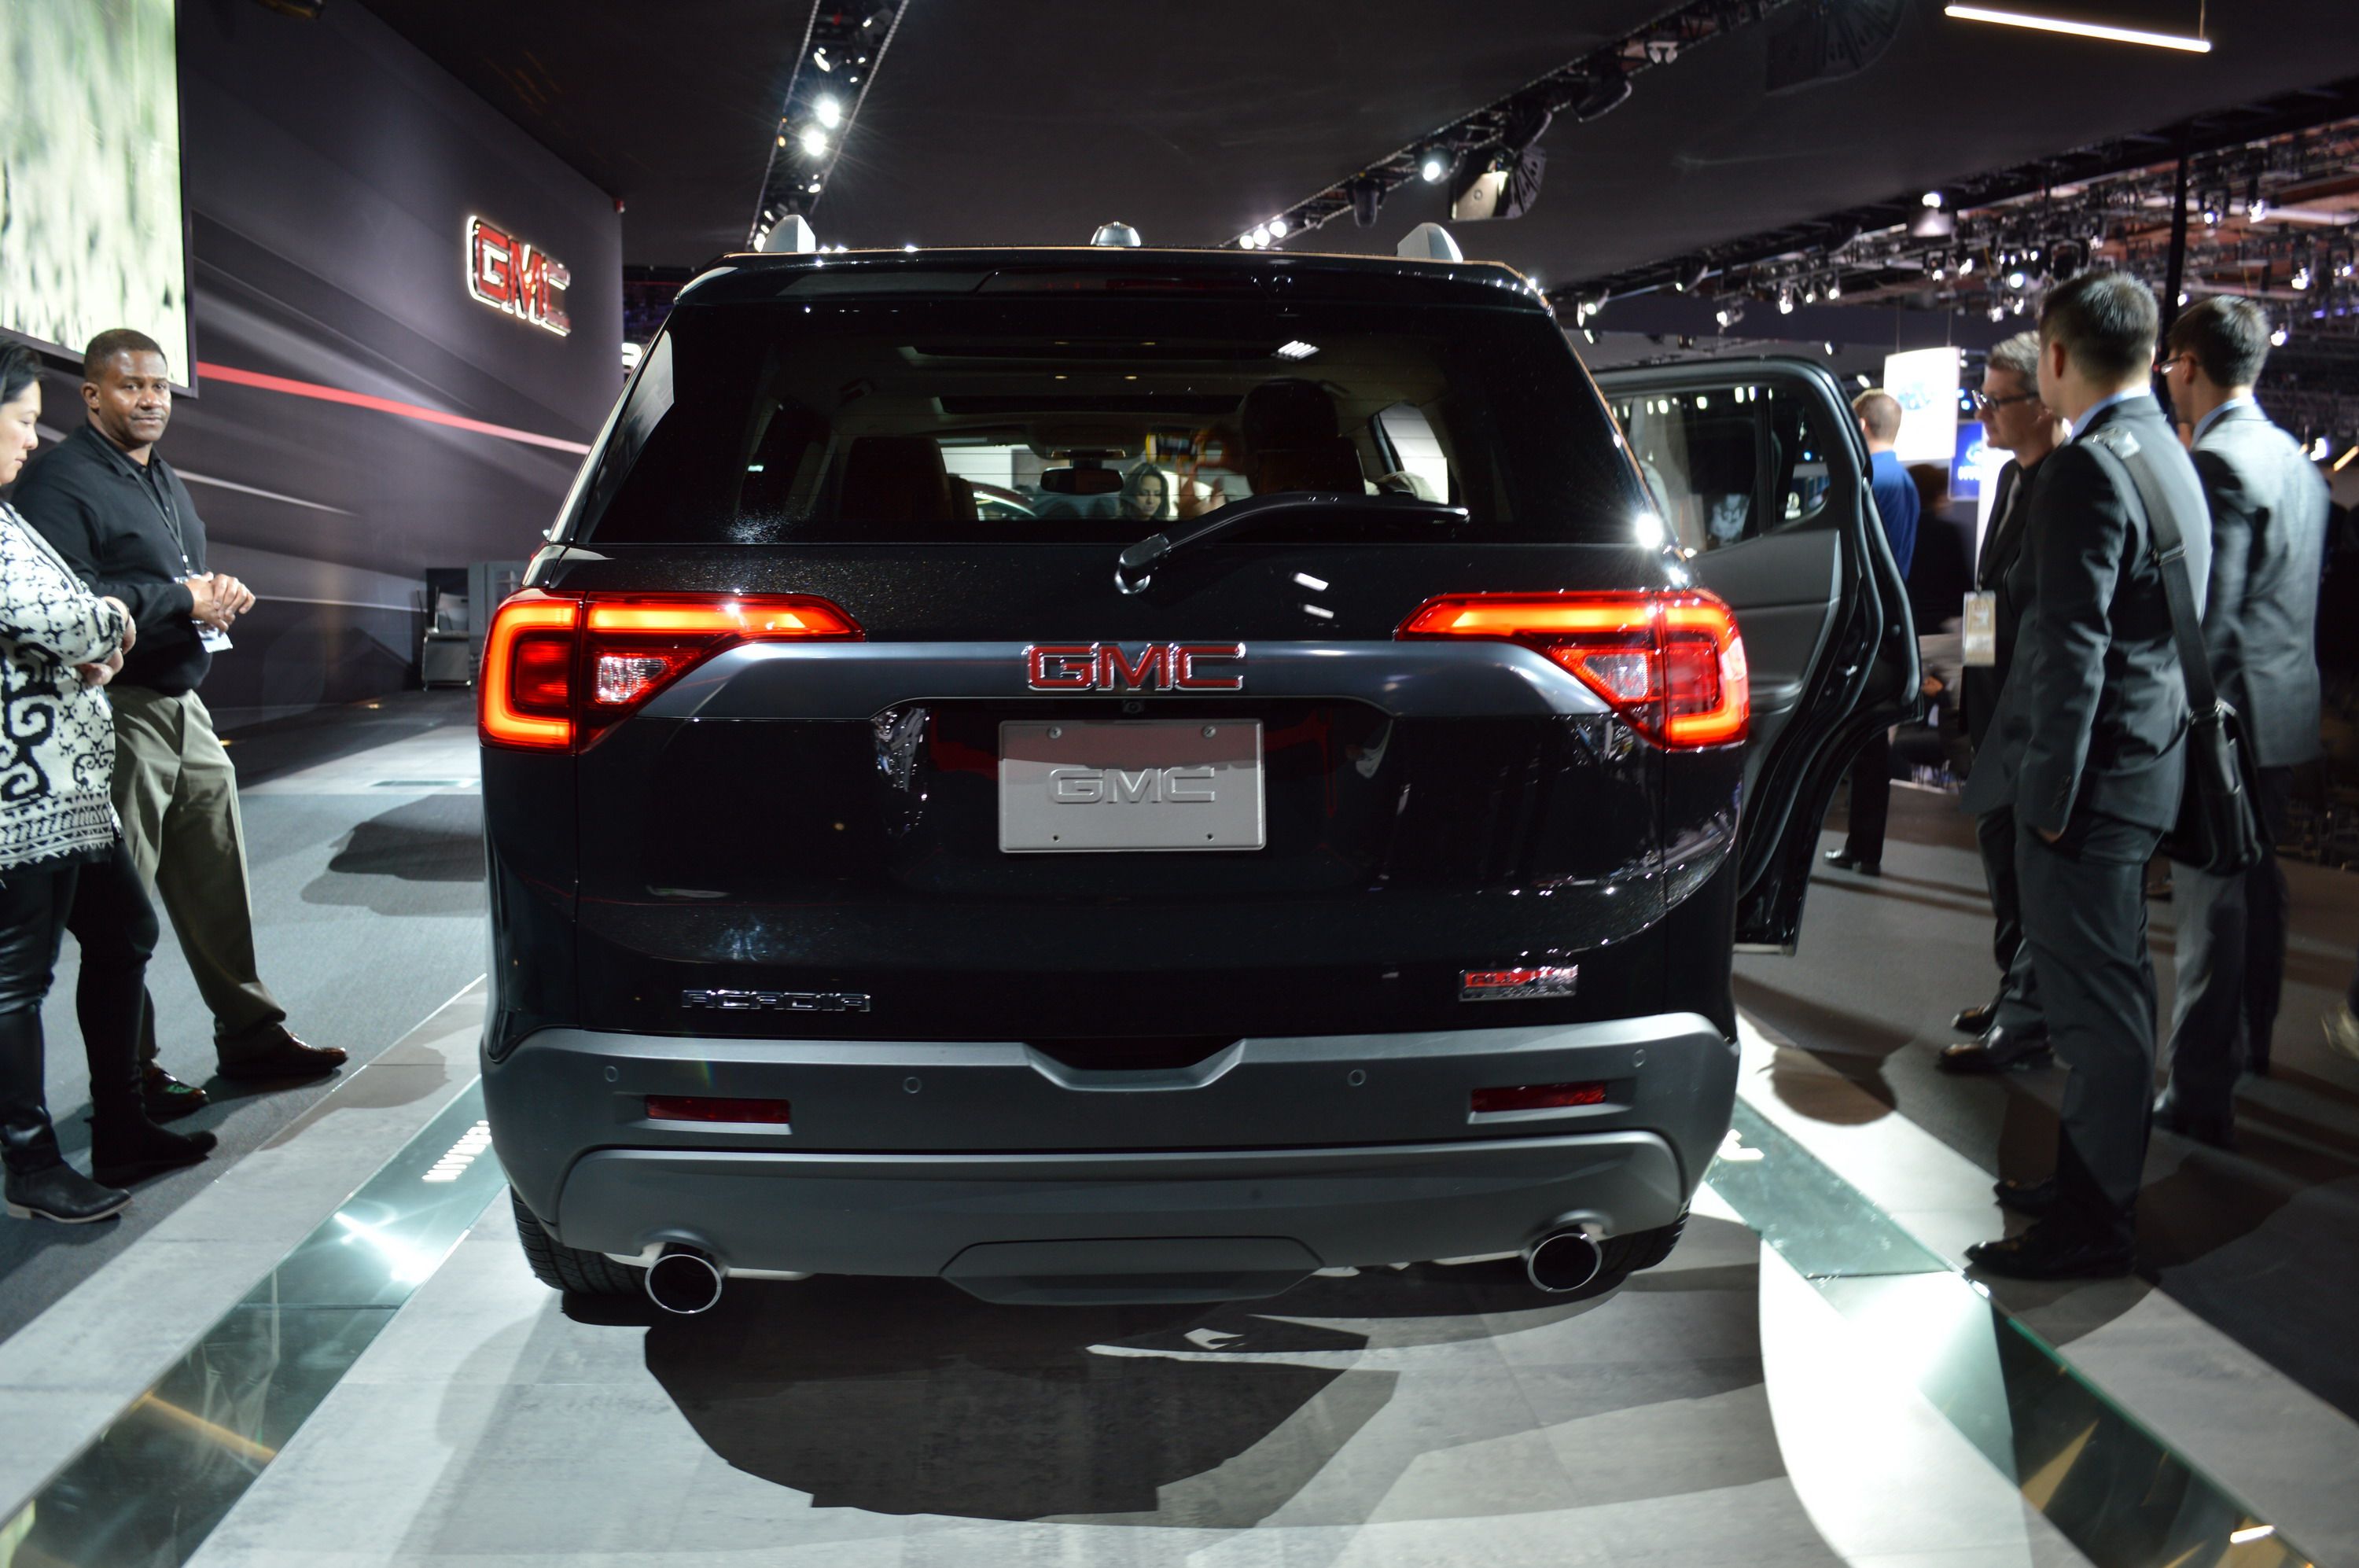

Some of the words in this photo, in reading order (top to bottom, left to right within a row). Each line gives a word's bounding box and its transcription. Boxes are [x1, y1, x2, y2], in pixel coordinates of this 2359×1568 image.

[467, 215, 571, 337] GMC
[1027, 642, 1245, 691] GMC
[1049, 767, 1216, 804] GMC
[682, 989, 870, 1012] ACADIA
